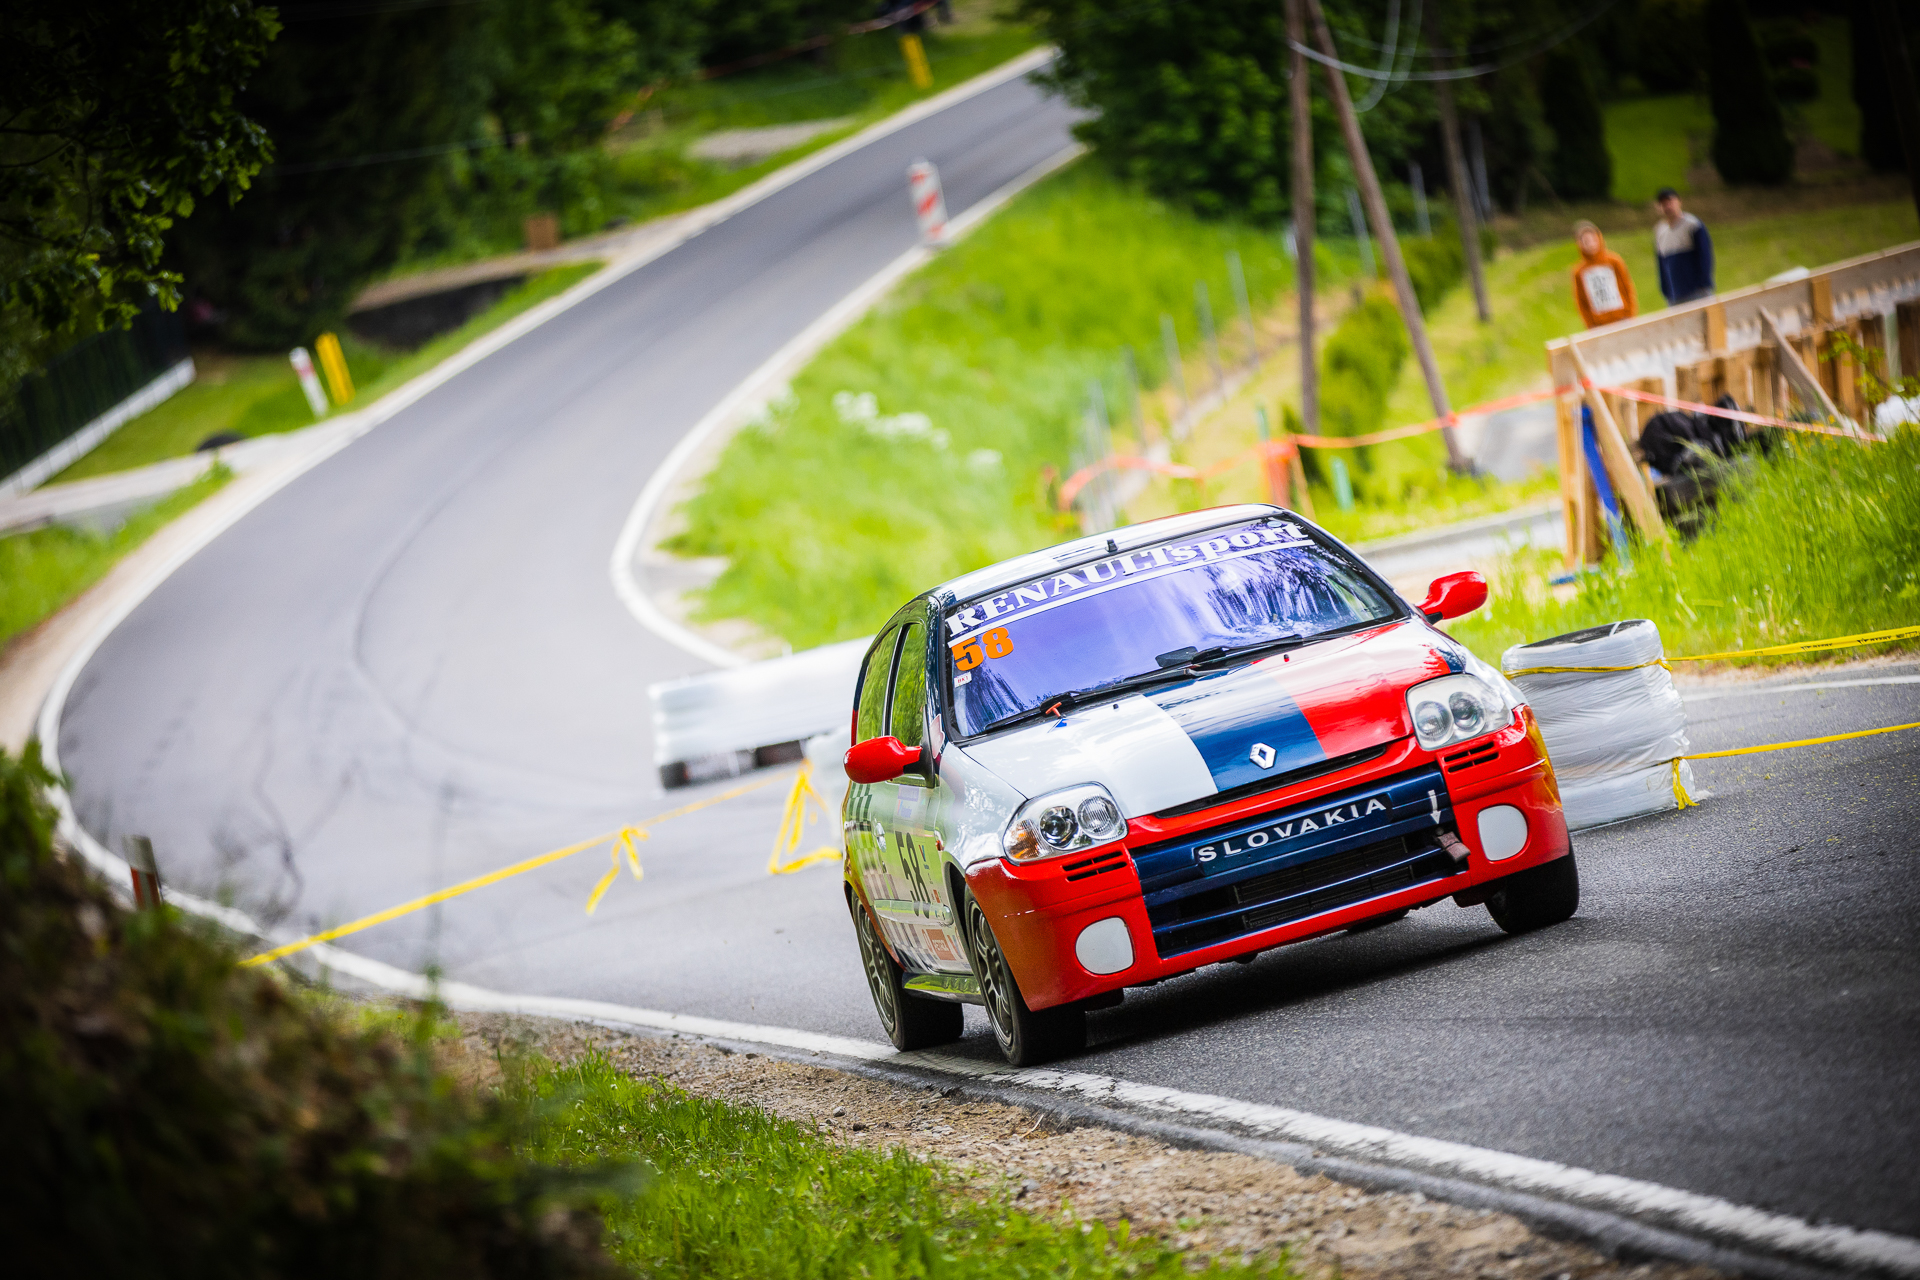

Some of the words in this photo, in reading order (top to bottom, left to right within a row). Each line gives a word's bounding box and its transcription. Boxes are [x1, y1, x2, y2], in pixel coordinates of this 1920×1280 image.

[945, 522, 1309, 637] RENAULTsport
[951, 627, 1014, 672] 58
[1198, 798, 1387, 862] SLOVAKIA
[895, 830, 932, 919] 58
